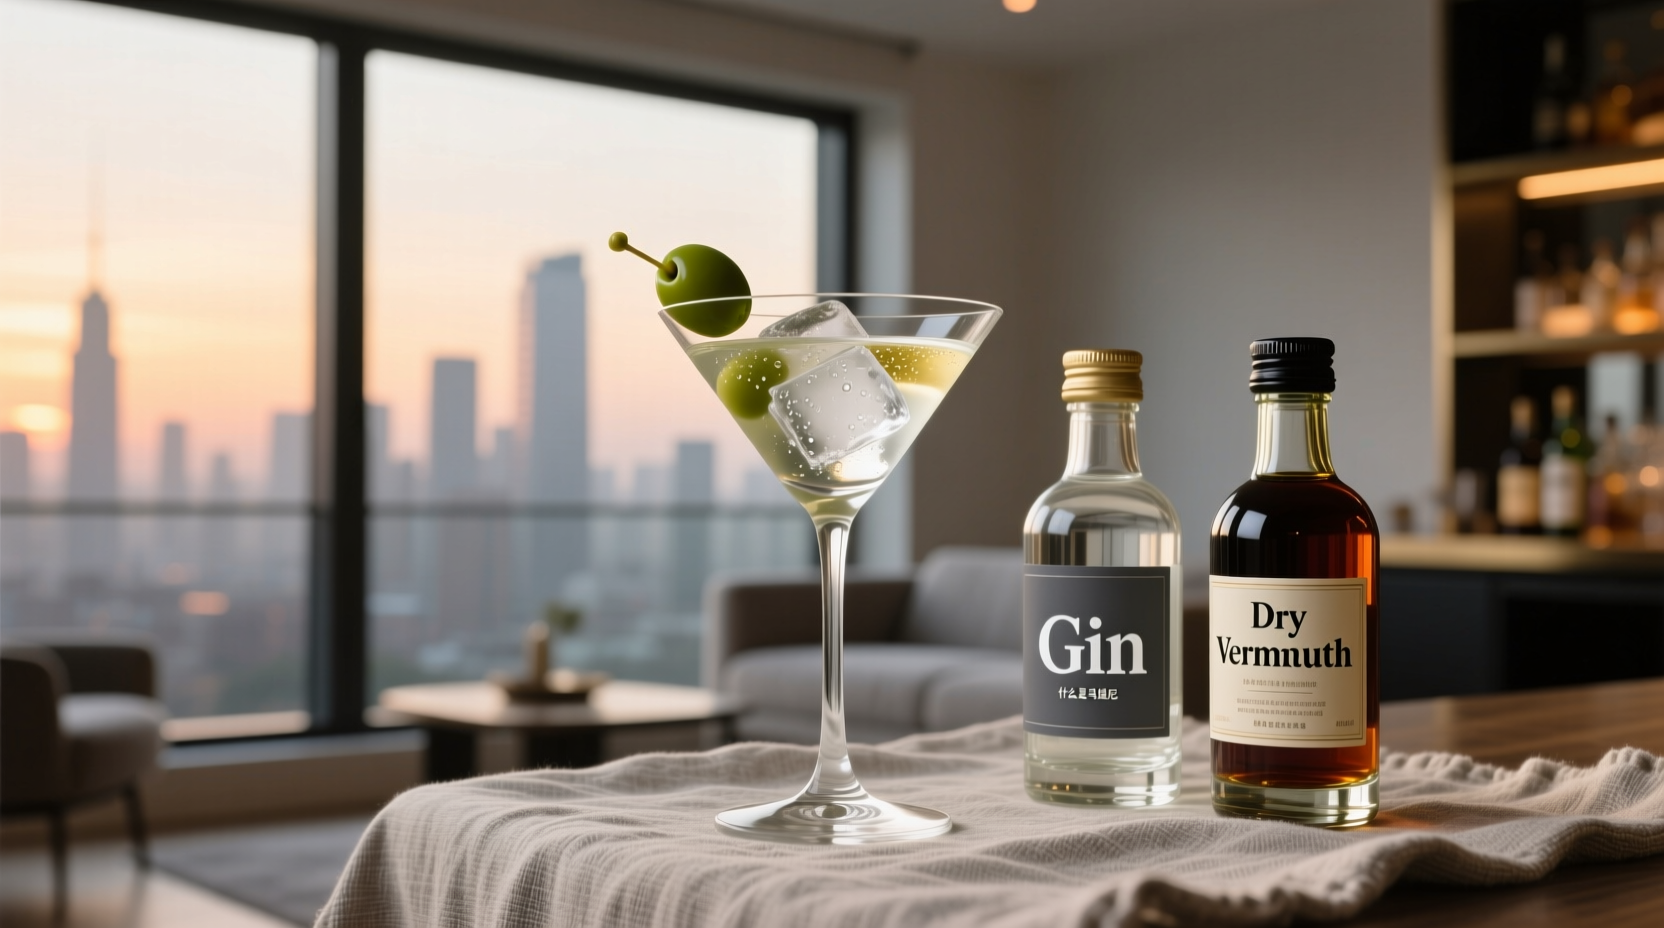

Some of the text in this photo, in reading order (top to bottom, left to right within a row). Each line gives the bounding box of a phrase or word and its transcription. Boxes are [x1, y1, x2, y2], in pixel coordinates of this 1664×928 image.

[1250, 601, 1307, 638] Dry
[1038, 614, 1148, 675] Gin
[1216, 636, 1353, 669] Vermnuth
